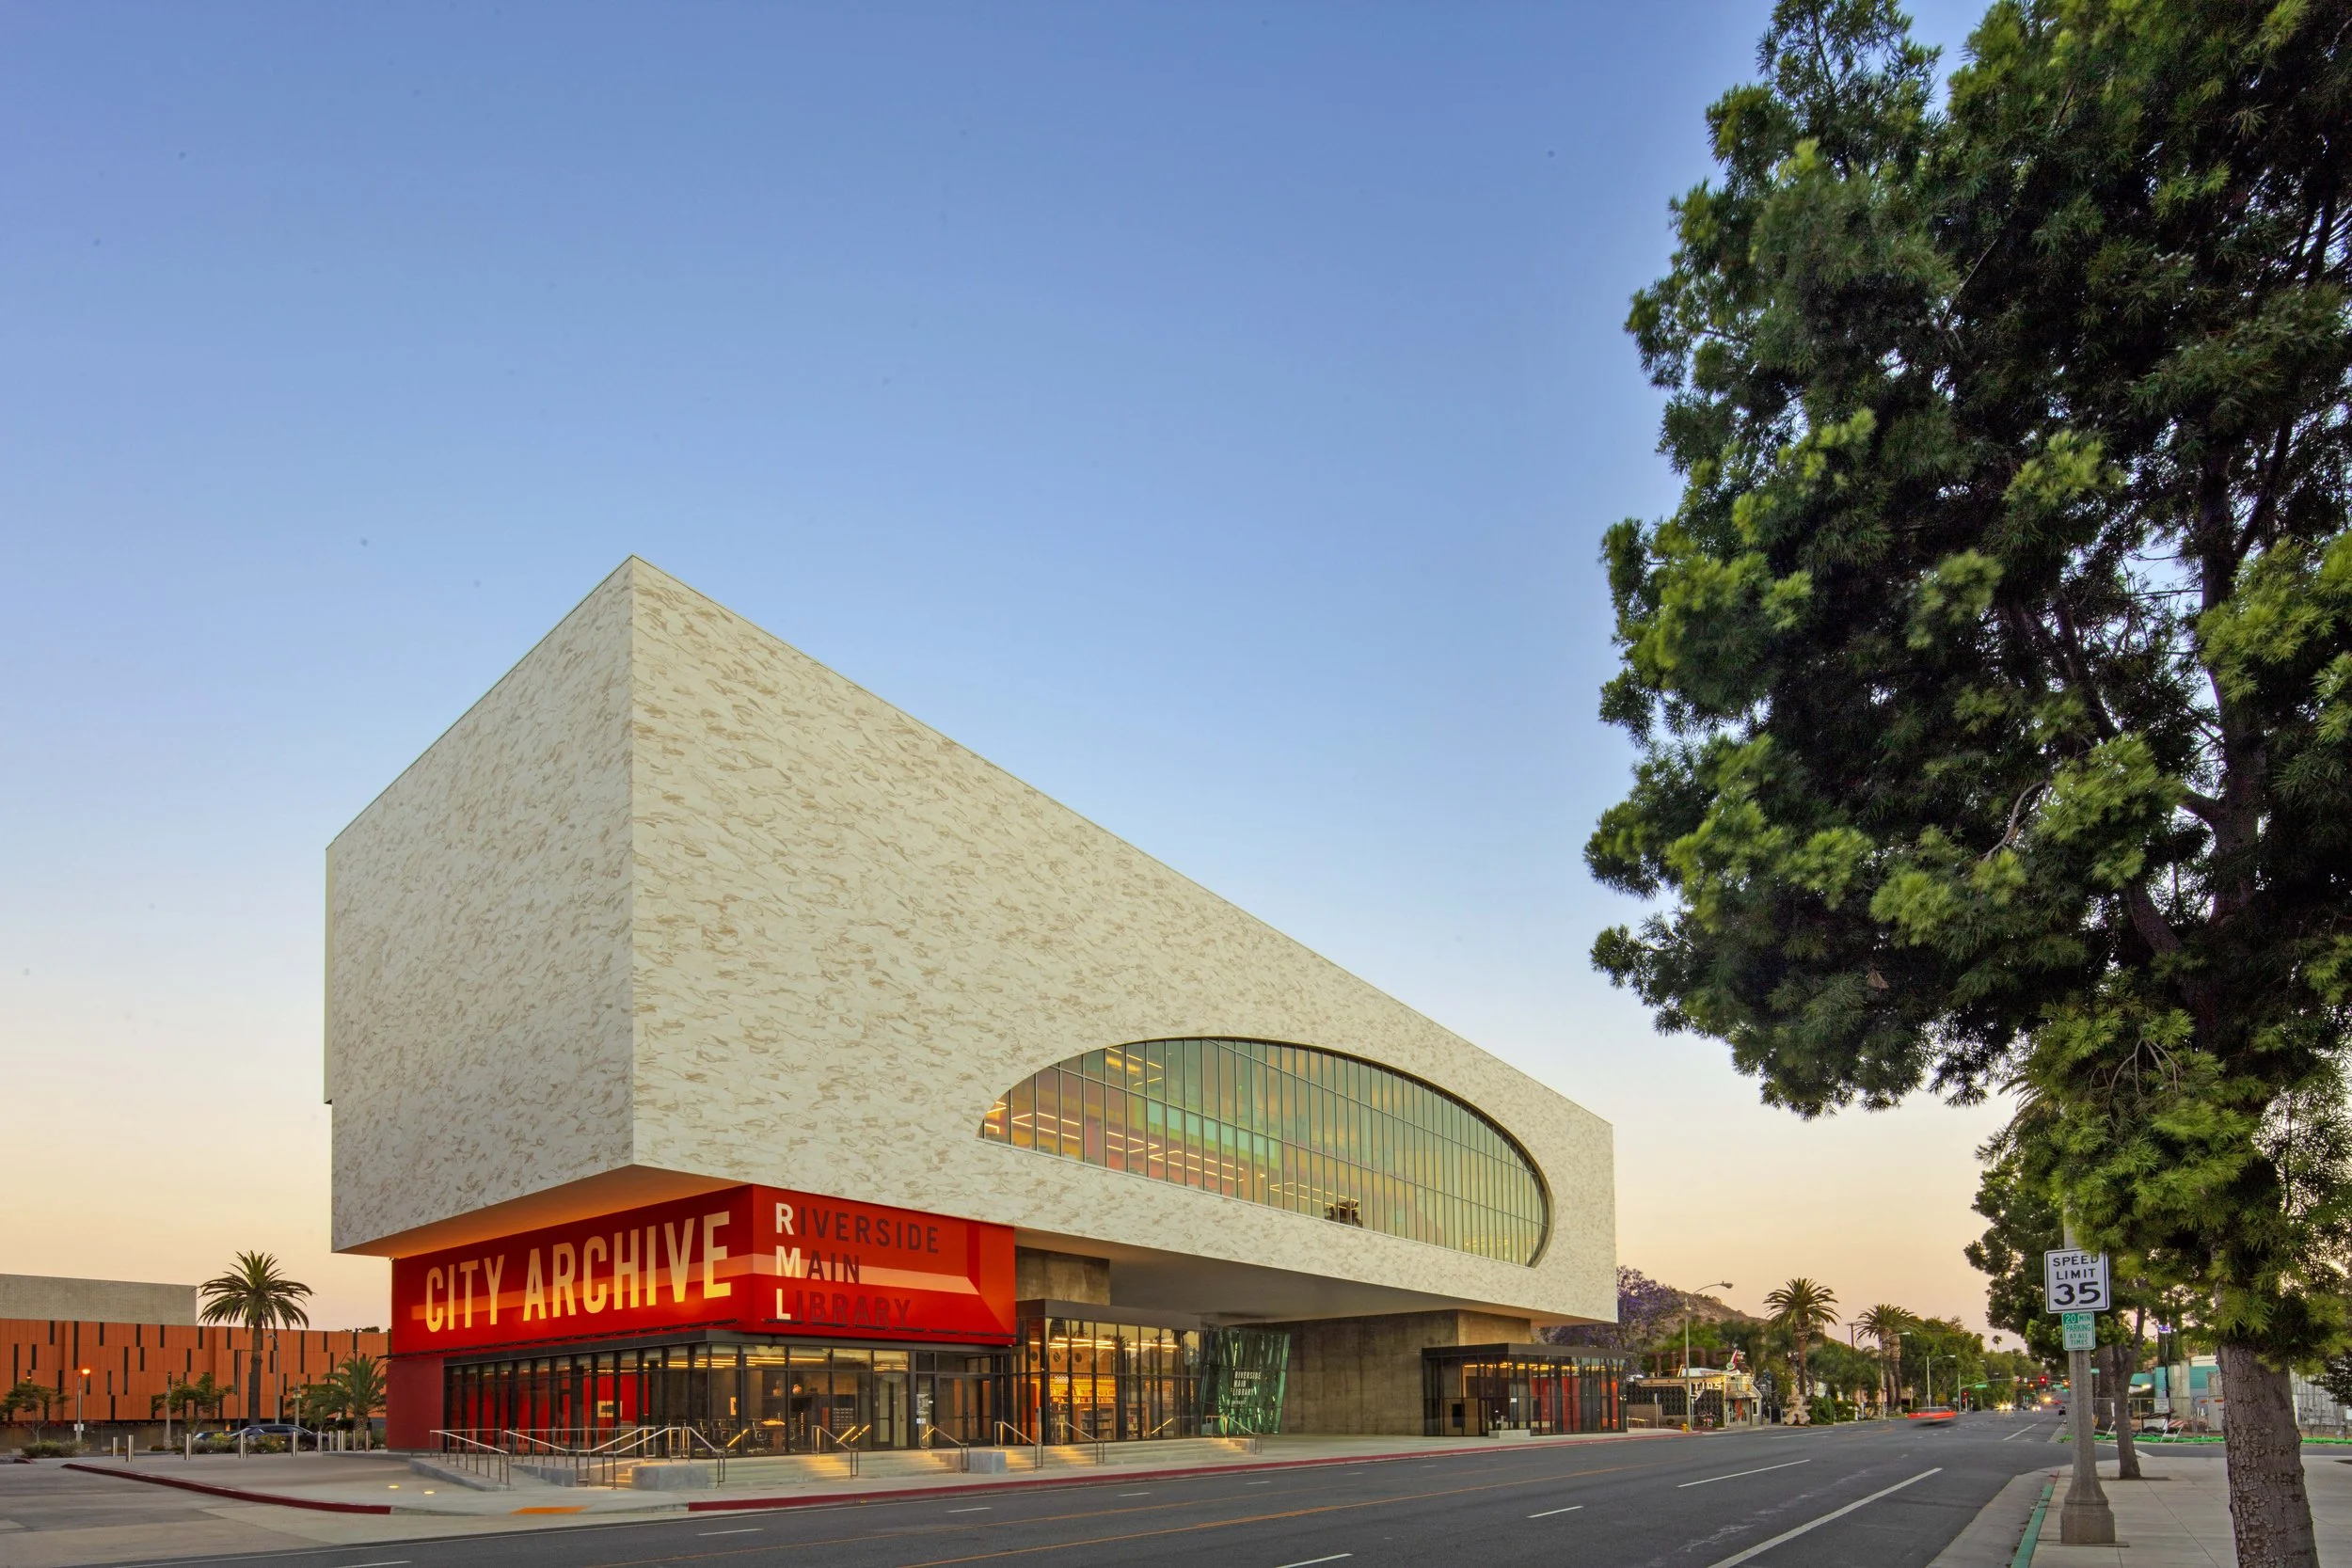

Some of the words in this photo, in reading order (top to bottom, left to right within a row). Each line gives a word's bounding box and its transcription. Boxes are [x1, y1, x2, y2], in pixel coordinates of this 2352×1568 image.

[776, 1202, 939, 1254] RIVERSIDE
[776, 1244, 860, 1284] MAIN
[2053, 1255, 2098, 1266] SPEED
[426, 1255, 505, 1333] CITY
[523, 1211, 731, 1322] ARCHIVE
[2057, 1268, 2096, 1280] LIMIT
[2054, 1281, 2101, 1306] 35
[776, 1288, 910, 1326] LIBRARY
[2065, 1314, 2076, 1323] 20
[1234, 1370, 1261, 1379] RIVERSIDE
[1233, 1379, 1247, 1387] MAIN
[1232, 1387, 1254, 1396] LIBRARY
